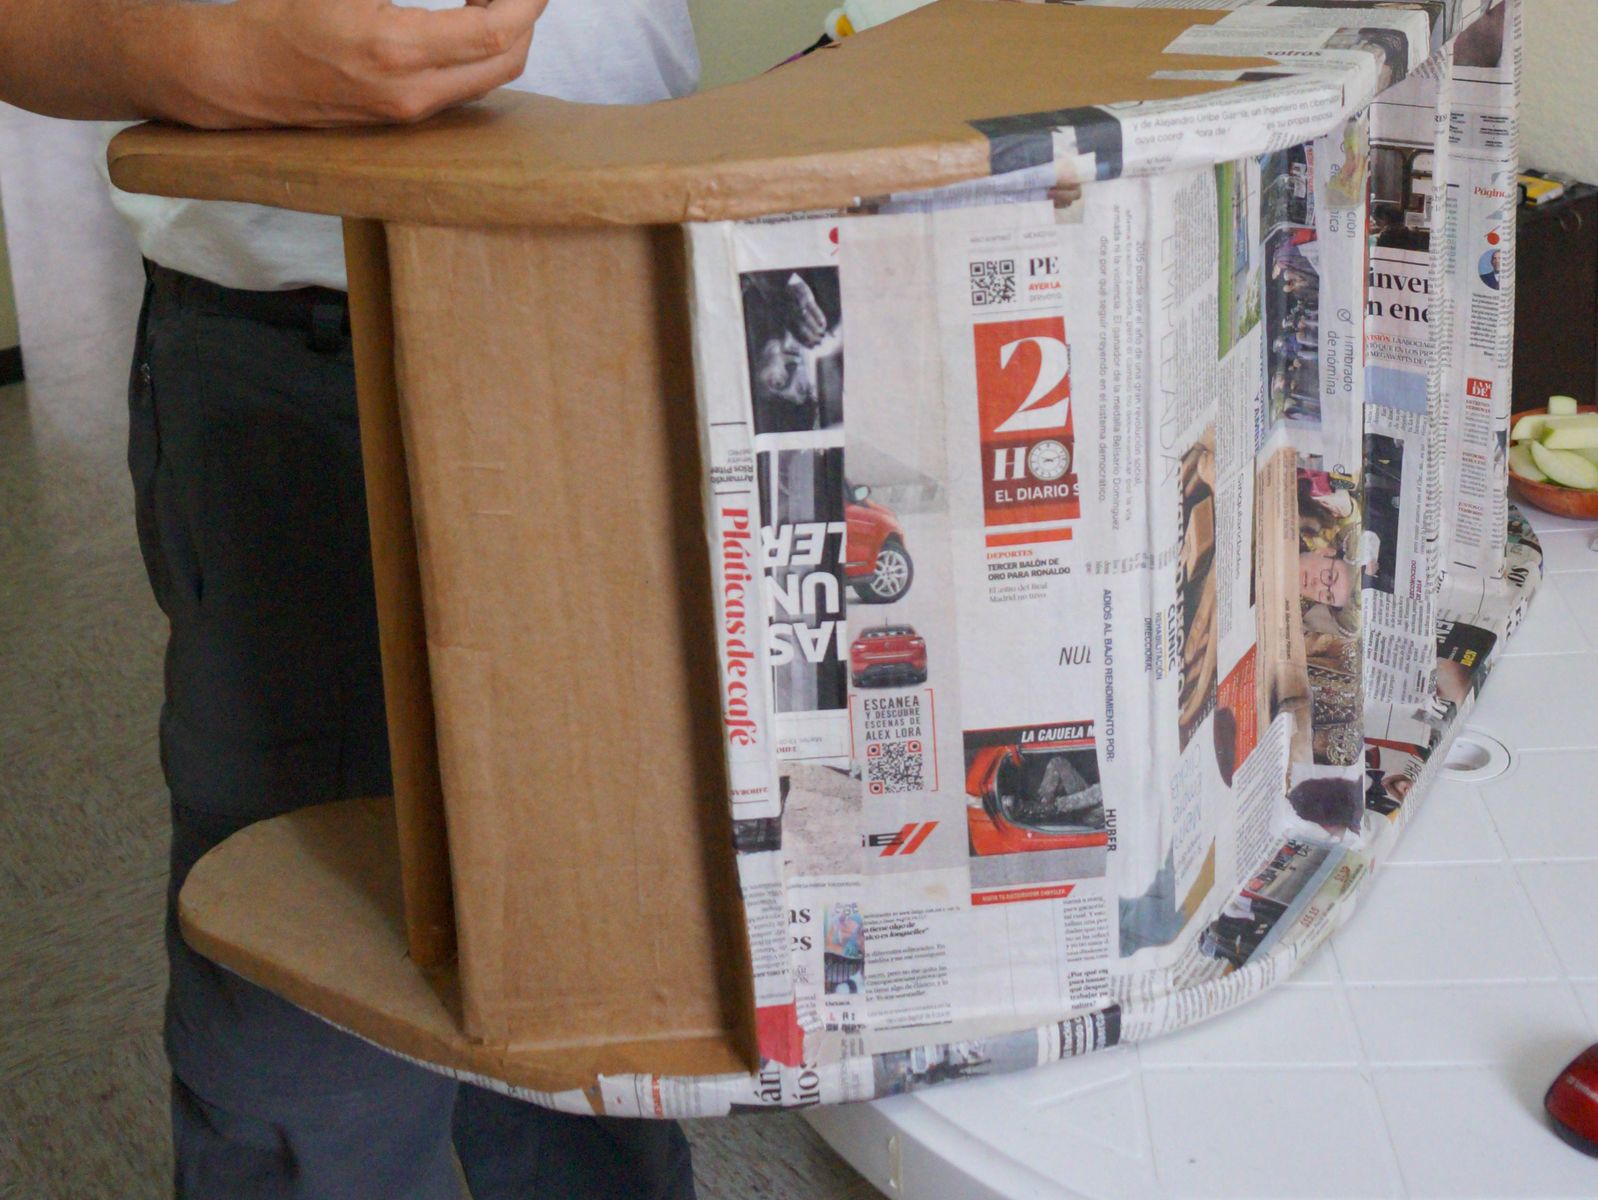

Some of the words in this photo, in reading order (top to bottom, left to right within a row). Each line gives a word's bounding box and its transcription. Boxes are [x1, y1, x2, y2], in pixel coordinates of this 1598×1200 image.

[1327, 331, 1340, 346] de
[995, 489, 1013, 503] EL
[1017, 484, 1069, 501] DIARIO
[722, 508, 753, 634] Pláticas
[988, 562, 1018, 572] TERCER
[1020, 558, 1046, 569] BALÓN
[1049, 558, 1059, 566] DE
[988, 572, 1005, 581] ORO
[1007, 569, 1029, 579] PARA
[1031, 567, 1070, 577] RONALDO
[1103, 589, 1114, 620] ADIÓS
[1104, 622, 1113, 636] AL
[726, 639, 755, 677] de
[1104, 638, 1113, 665] BAJO
[864, 695, 920, 711] ESCANEA
[1104, 668, 1114, 736] RENDIMIENTO
[723, 681, 757, 746] café
[875, 707, 920, 719] DESCUBRE
[865, 718, 905, 729] ESCENAS
[910, 717, 921, 725] DE
[865, 730, 891, 741] ALEX
[896, 726, 922, 738] LORA
[1021, 730, 1034, 743] LA
[1037, 726, 1084, 742] CAJUELA
[1106, 738, 1115, 762] POR:
[1105, 808, 1117, 852] HUBER
